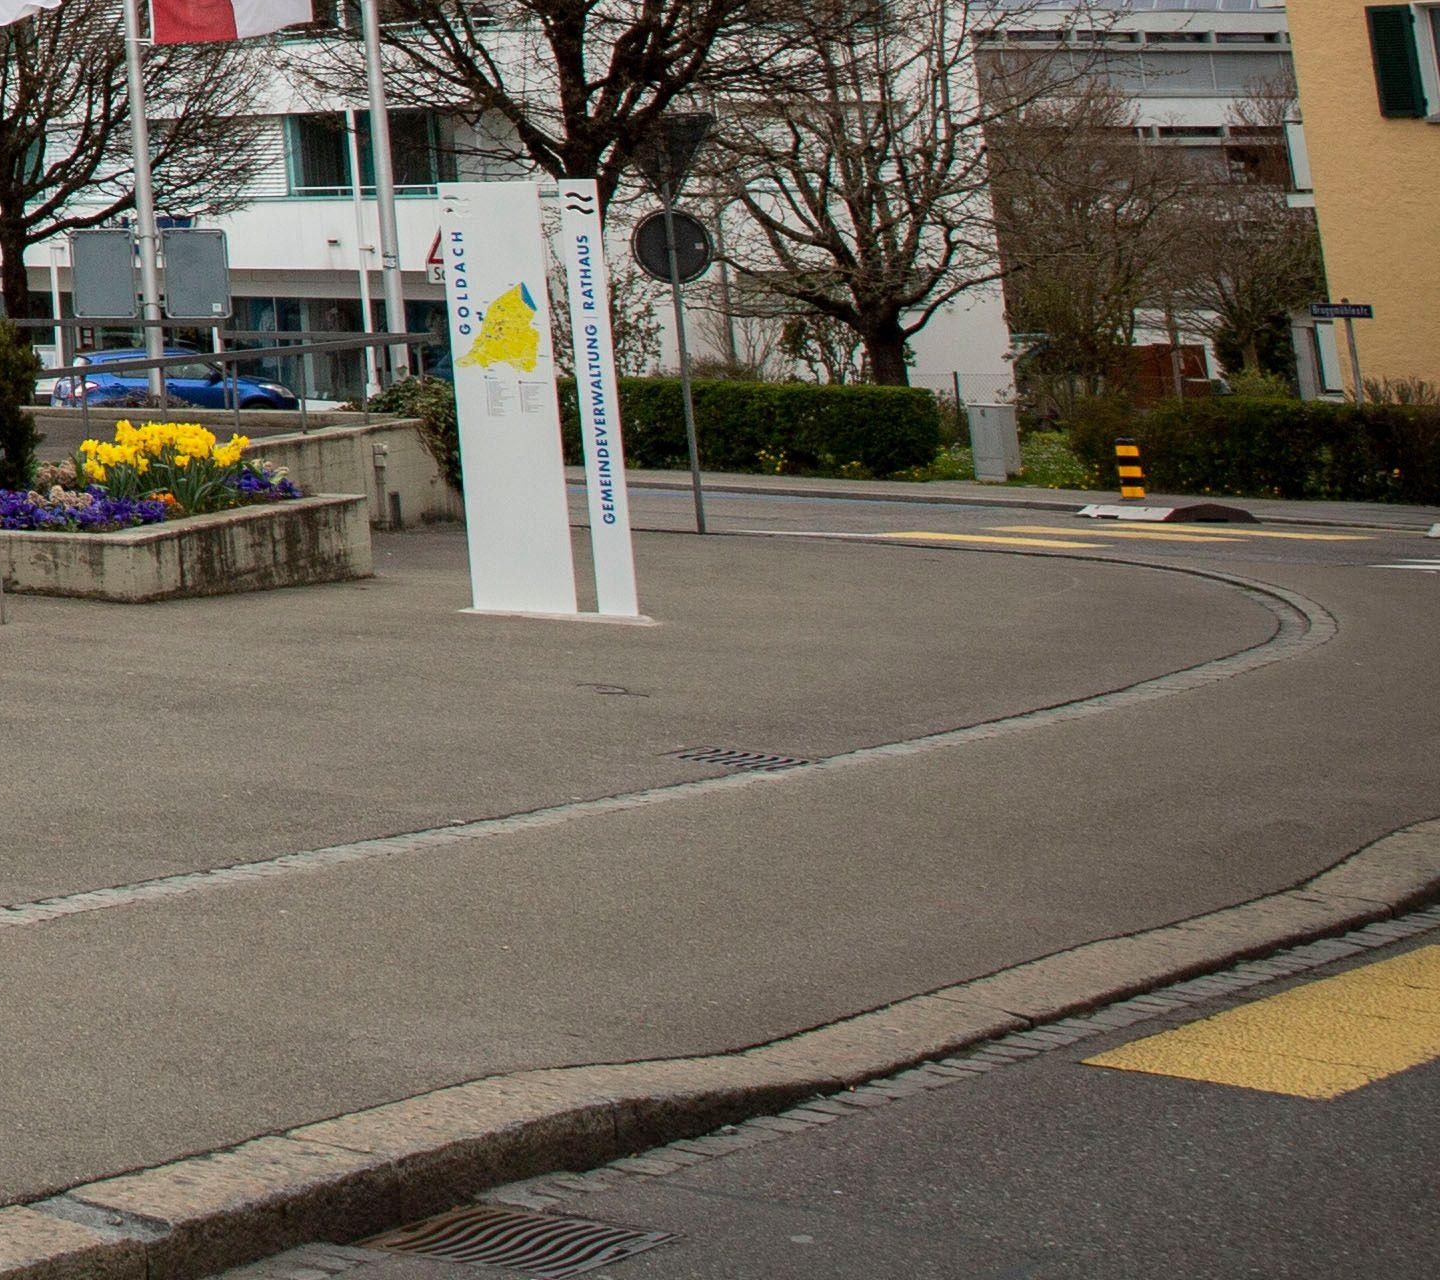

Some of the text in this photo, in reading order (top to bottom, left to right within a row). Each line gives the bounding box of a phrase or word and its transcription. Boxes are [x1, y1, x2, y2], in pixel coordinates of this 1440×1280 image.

[451, 231, 472, 336] GOLDACH
[576, 235, 616, 525] GEMEINDEVERWALTUNG RATHAUS
